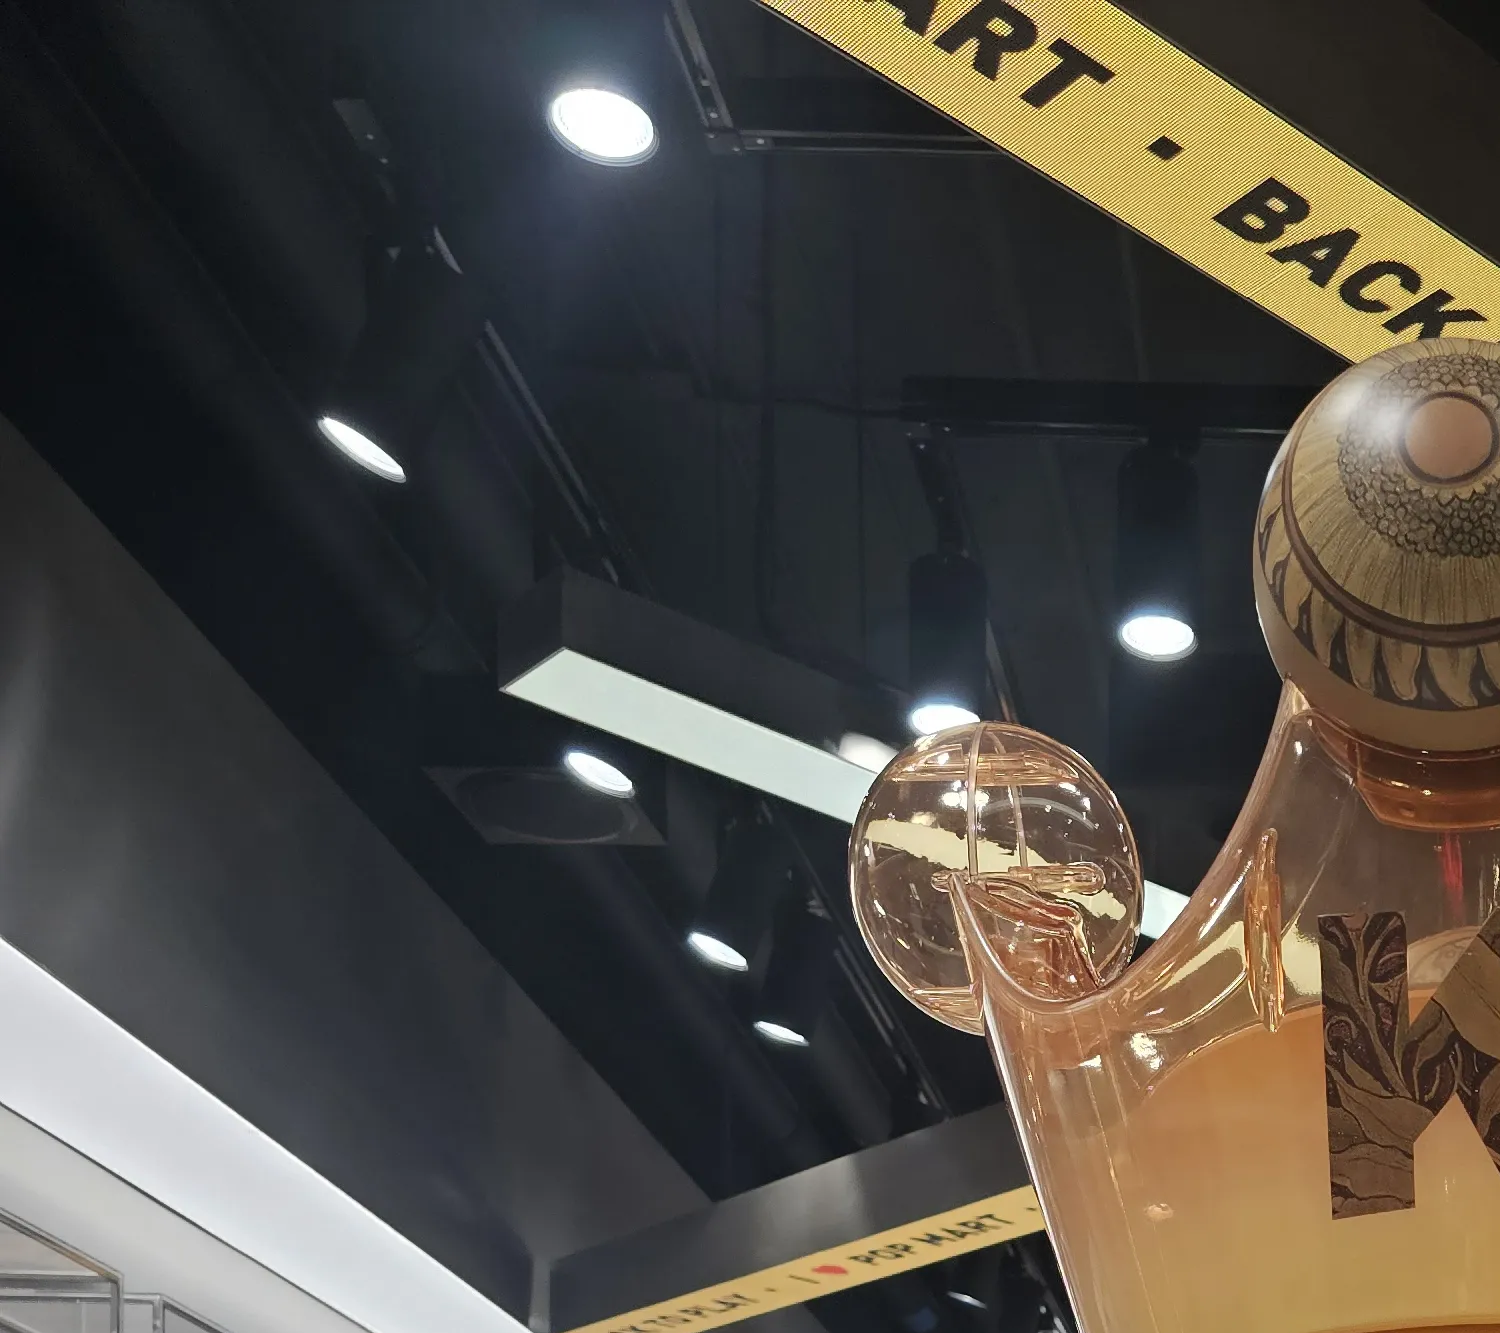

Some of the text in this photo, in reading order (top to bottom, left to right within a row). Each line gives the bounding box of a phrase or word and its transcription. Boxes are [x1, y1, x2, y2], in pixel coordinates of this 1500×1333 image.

[1211, 177, 1487, 340] BACK
[681, 1292, 758, 1323] PLAY
[849, 1242, 918, 1267] POP
[911, 1211, 1015, 1250] MART
